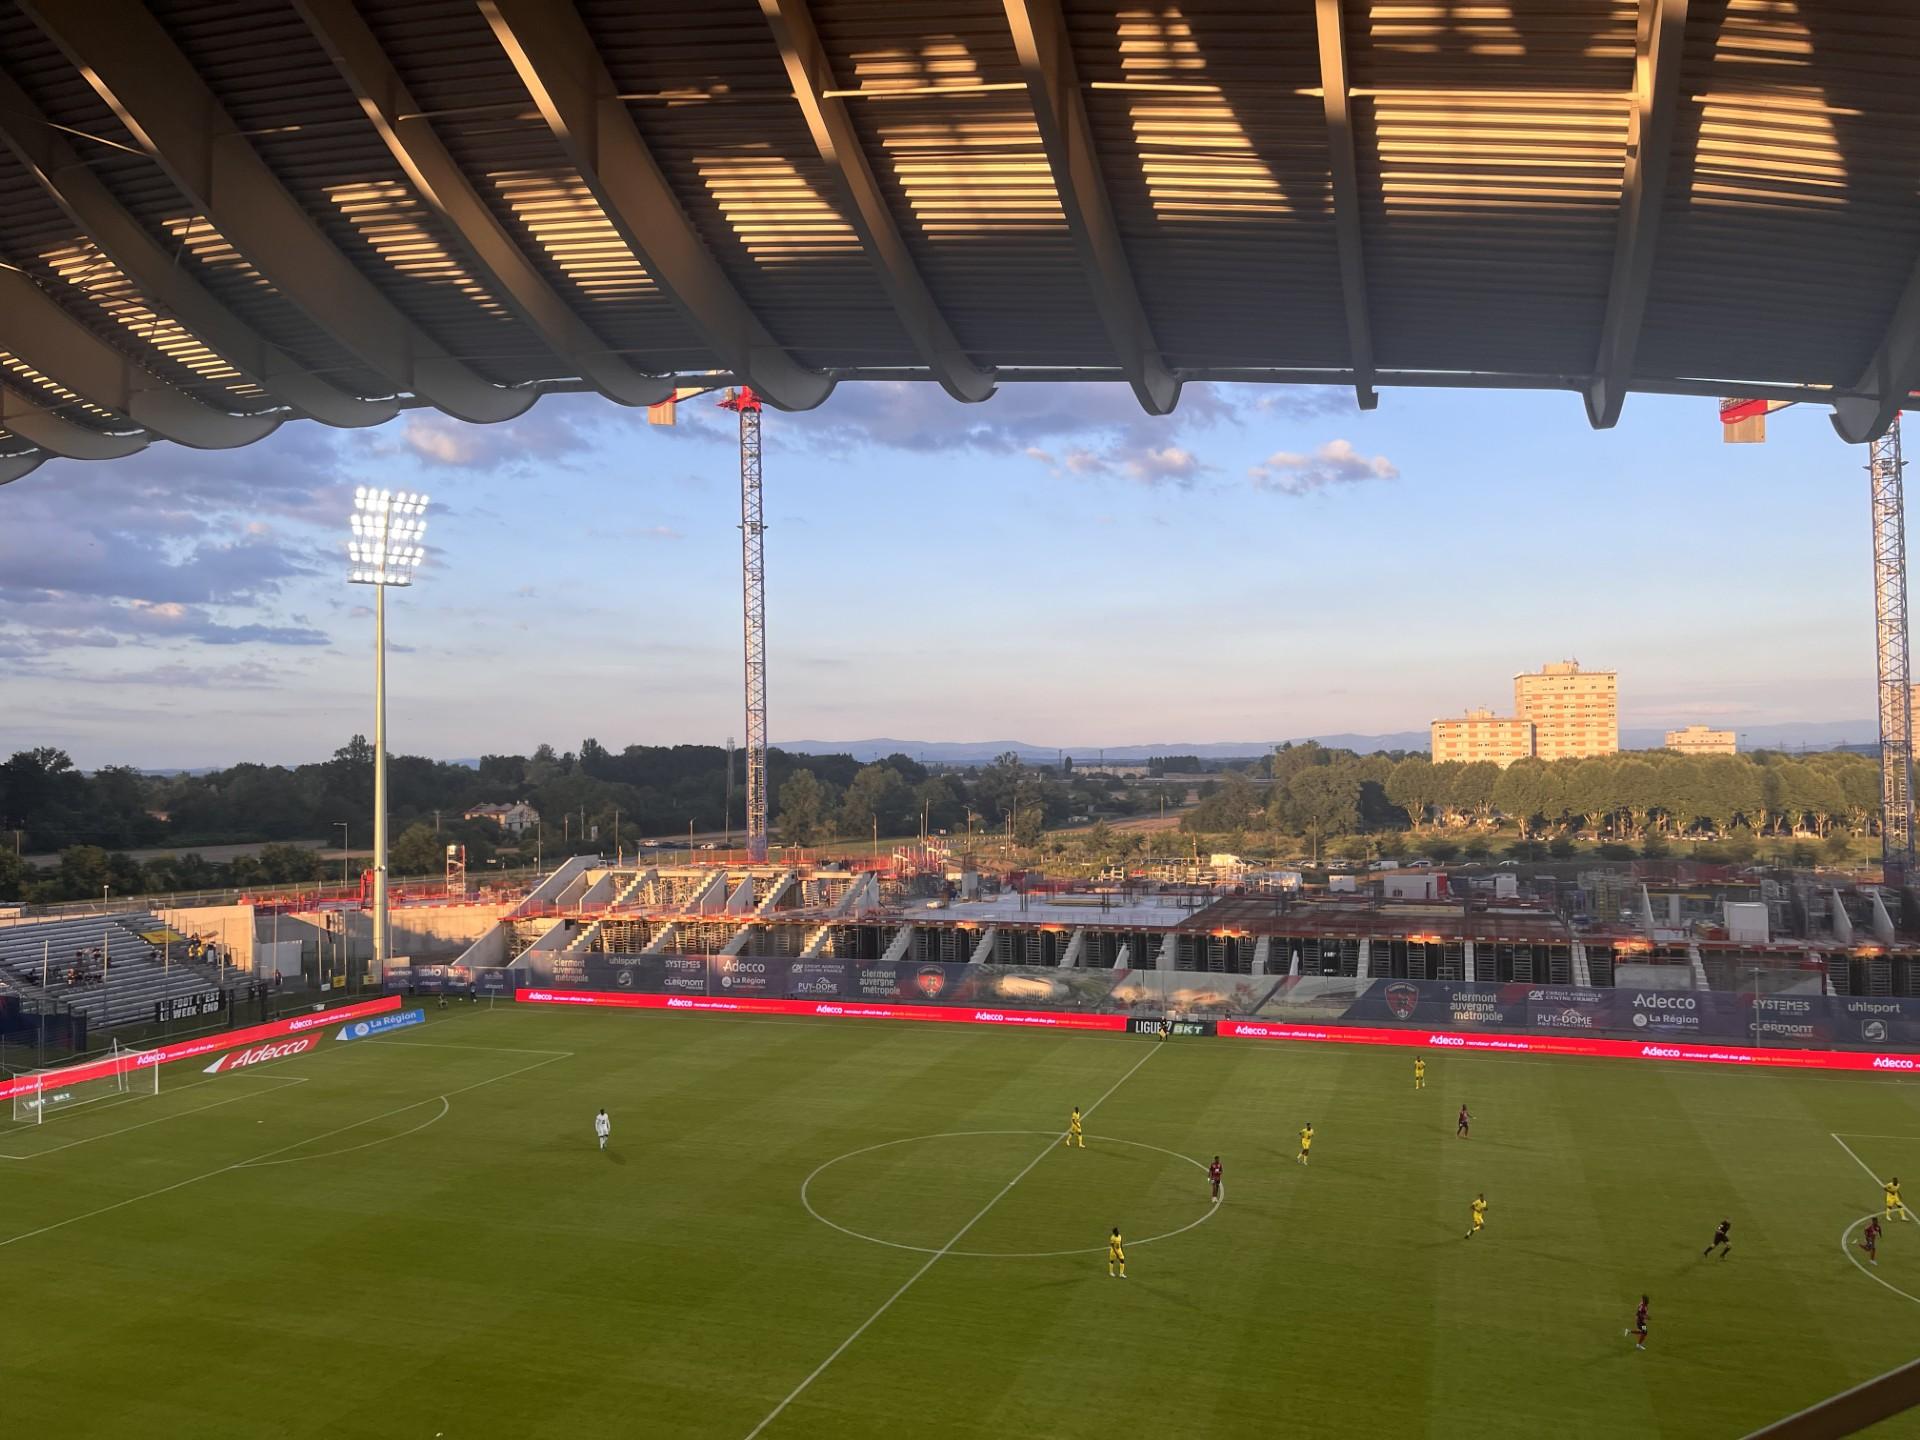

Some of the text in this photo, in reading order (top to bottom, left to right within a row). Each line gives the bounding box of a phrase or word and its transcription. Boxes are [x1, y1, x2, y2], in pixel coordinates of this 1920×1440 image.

[723, 960, 765, 973] Adecco
[862, 969, 896, 979] clermont
[860, 978, 895, 987] auvergne
[173, 995, 194, 1009] FOOT
[528, 992, 553, 1001] Adecco
[667, 998, 693, 1007] Adecco
[1452, 991, 1497, 1003] clermont
[1633, 993, 1696, 1010] Adecco
[816, 1004, 842, 1014] Adecco
[1450, 1001, 1494, 1013] auvergne
[1848, 1002, 1900, 1014] uhlsport
[370, 1020, 382, 1028] La
[383, 1012, 417, 1025] Région
[975, 1011, 1003, 1021] Adecco
[1454, 1010, 1503, 1022] métropole
[1649, 1014, 1699, 1025] La Région
[289, 1019, 313, 1031] Adecco
[1235, 1026, 1267, 1035] Adecco
[1429, 1035, 1464, 1046] Adecco
[230, 1039, 309, 1069] Adecco
[1642, 1046, 1680, 1057] Adecco
[1873, 1057, 1913, 1069] Adecco
